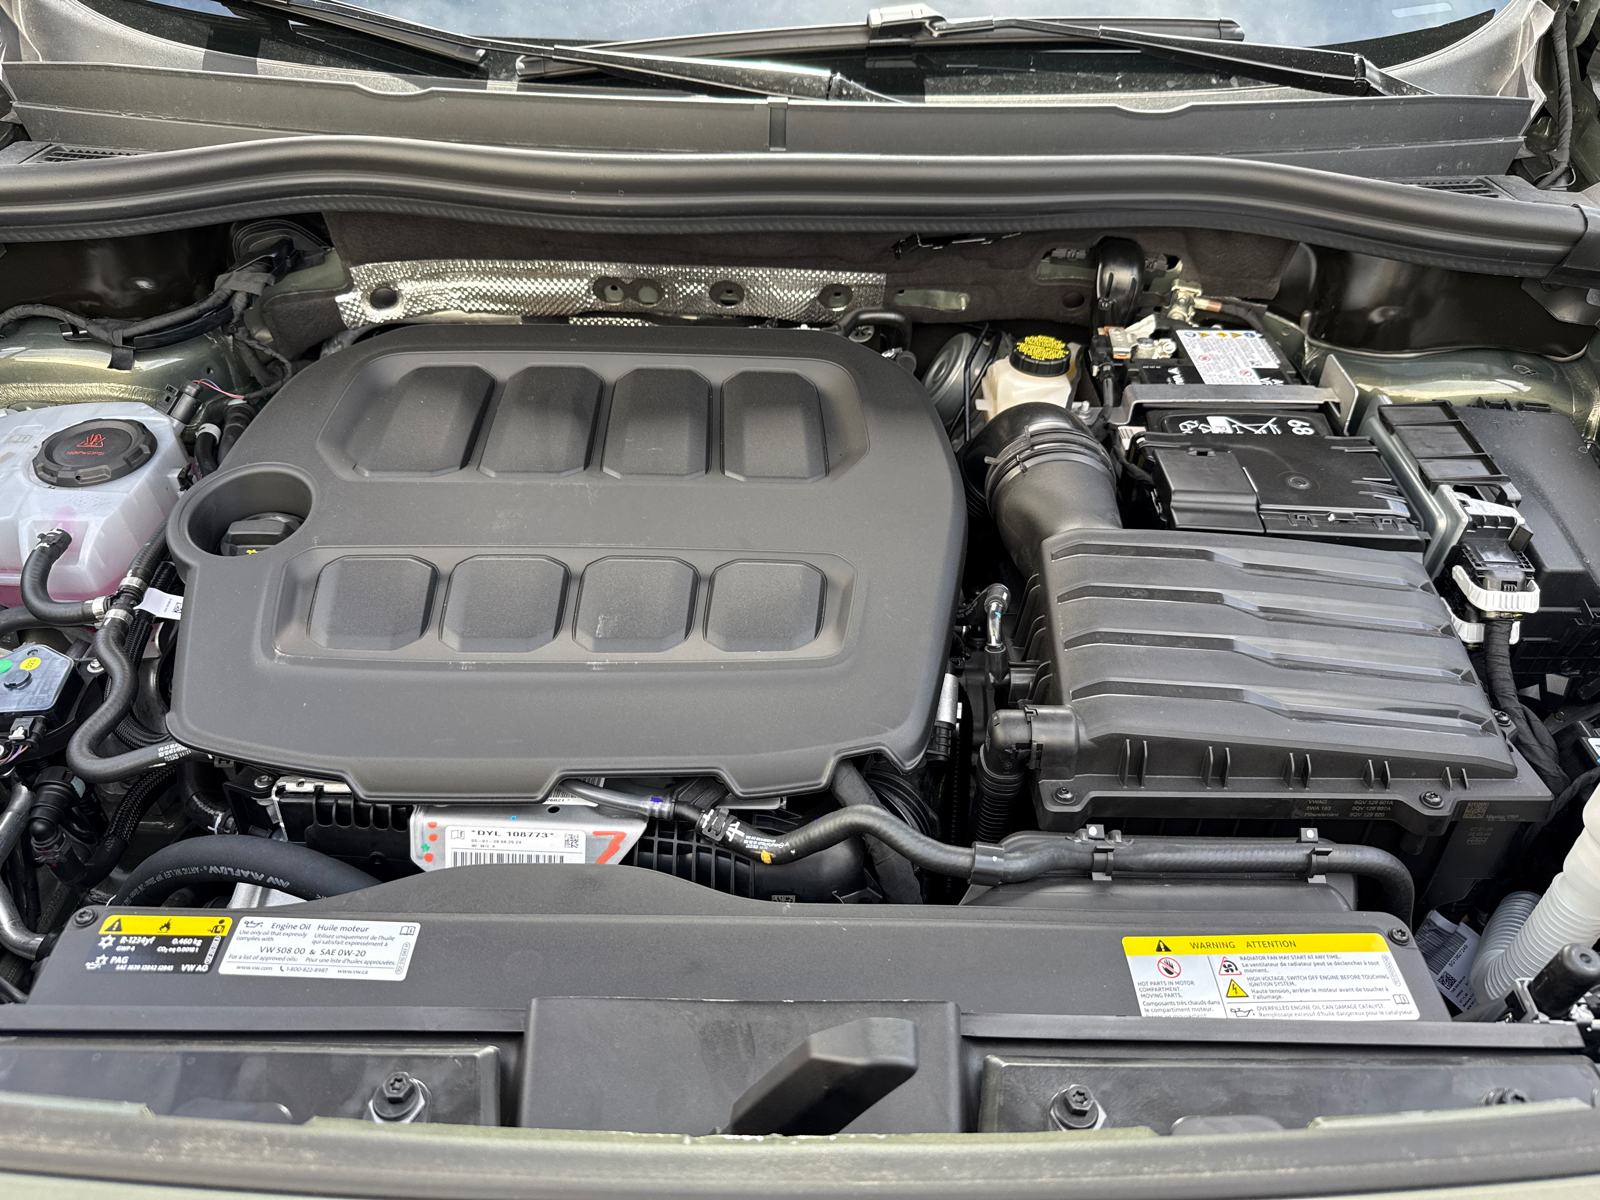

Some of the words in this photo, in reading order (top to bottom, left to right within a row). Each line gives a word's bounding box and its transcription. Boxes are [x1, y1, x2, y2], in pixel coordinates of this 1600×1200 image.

[271, 922, 298, 931] Engine
[120, 936, 157, 946] R-1234yf
[1189, 941, 1236, 949] WARNING
[1246, 940, 1296, 949] ATTENTION
